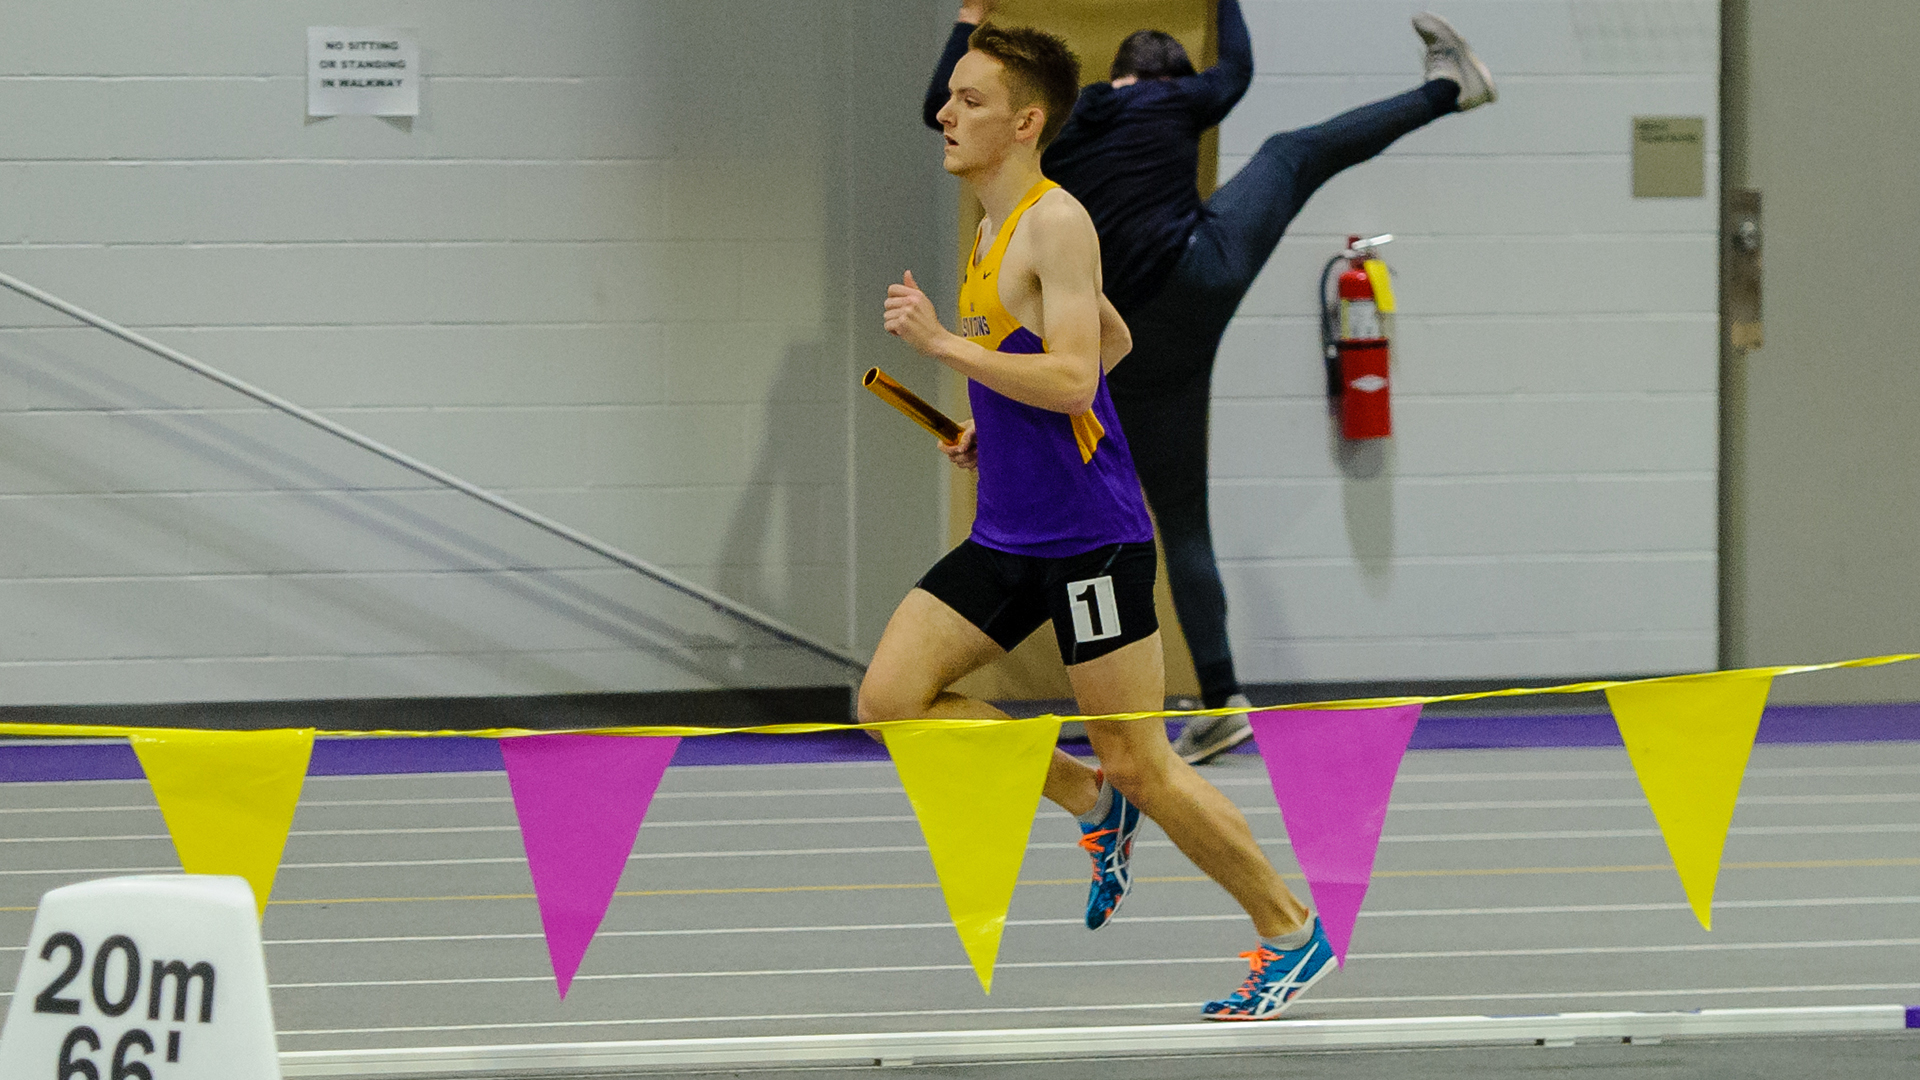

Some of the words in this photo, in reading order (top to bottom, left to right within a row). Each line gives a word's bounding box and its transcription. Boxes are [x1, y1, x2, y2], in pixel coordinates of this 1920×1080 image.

[325, 41, 343, 50] NO
[348, 41, 399, 50] SITTING
[320, 60, 336, 69] OR
[341, 60, 406, 69] STANDING
[322, 79, 335, 88] IN
[339, 79, 402, 88] WALKWAY
[1076, 584, 1104, 636] 1
[33, 931, 216, 1024] 20m
[57, 1025, 181, 1080] 66'
